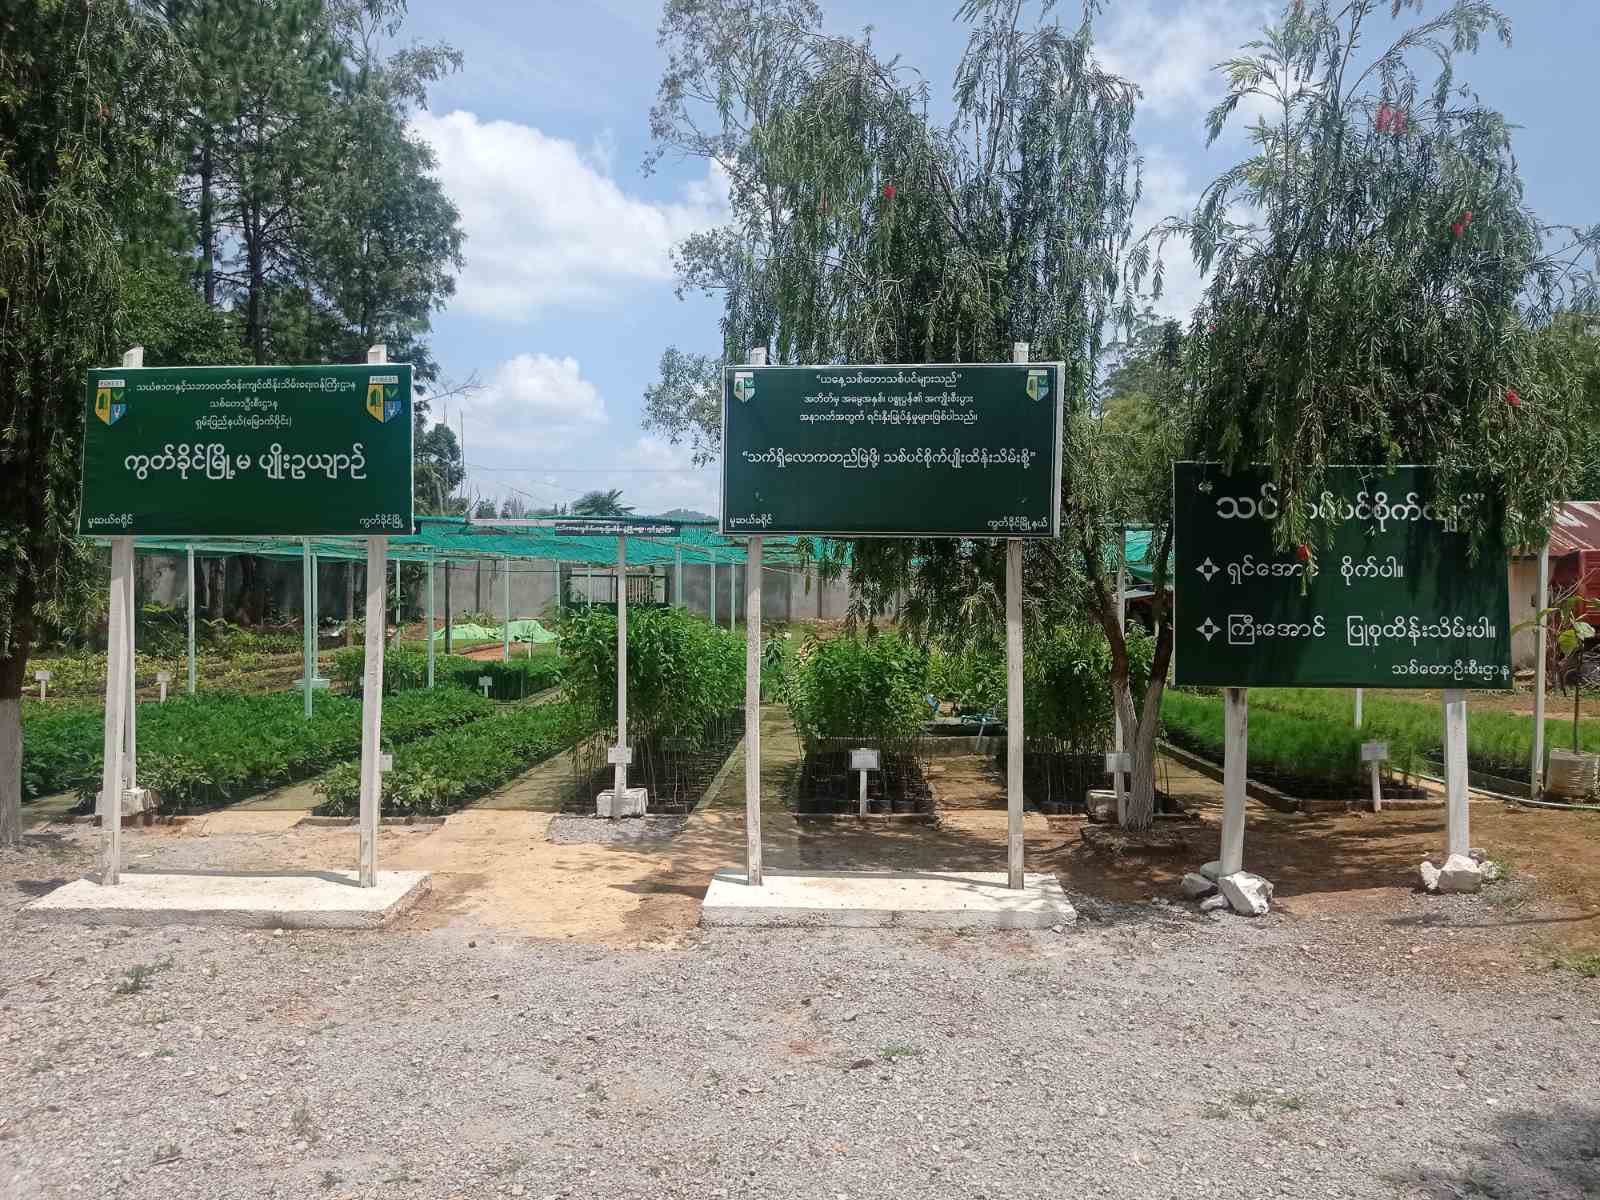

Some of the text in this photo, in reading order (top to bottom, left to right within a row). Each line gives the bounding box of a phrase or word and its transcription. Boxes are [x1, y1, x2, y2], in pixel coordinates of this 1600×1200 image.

[1227, 614, 1326, 646] ကြီးအောင်
[1391, 658, 1510, 681] သစ်တောဦးစီးဌာန
